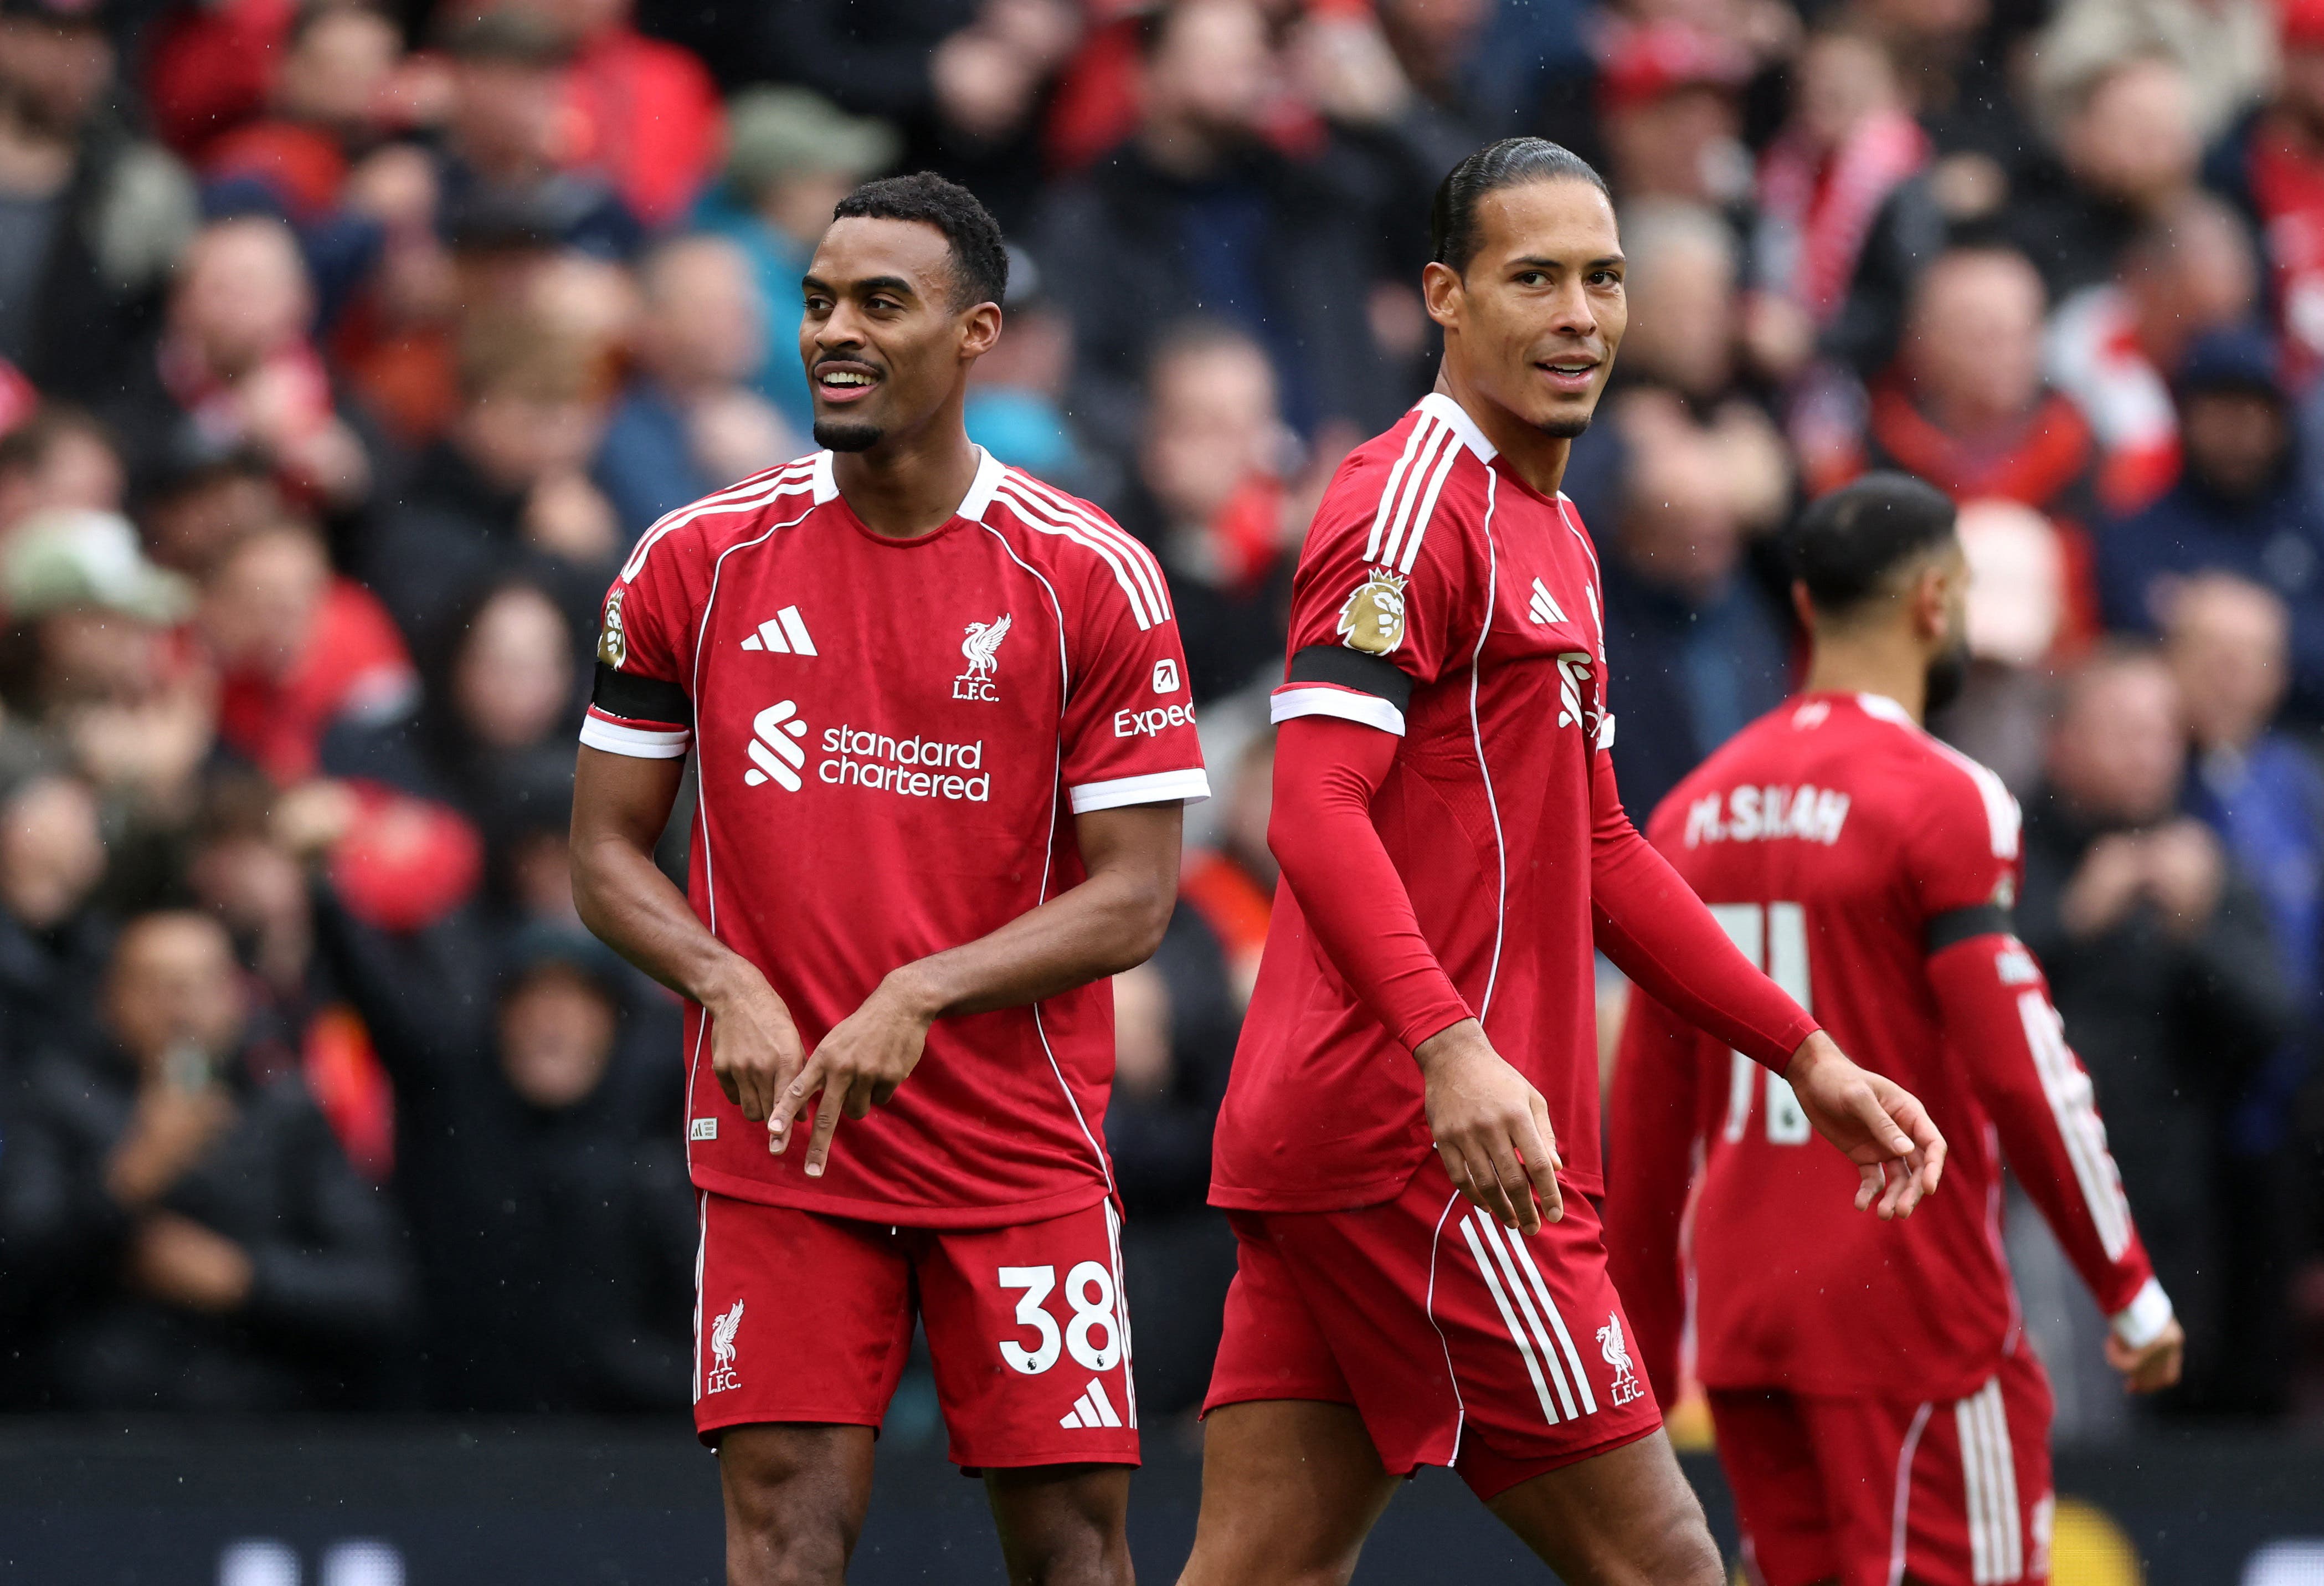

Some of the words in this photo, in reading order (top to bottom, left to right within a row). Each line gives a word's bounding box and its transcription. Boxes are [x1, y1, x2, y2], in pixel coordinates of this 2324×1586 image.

[952, 681, 1000, 702] L.F.C.
[822, 723, 982, 769] standard
[819, 754, 990, 802] chartered
[998, 1260, 1122, 1375] 38
[707, 1371, 742, 1395] L.F.C.
[1611, 1379, 1645, 1407] L.F.C.
